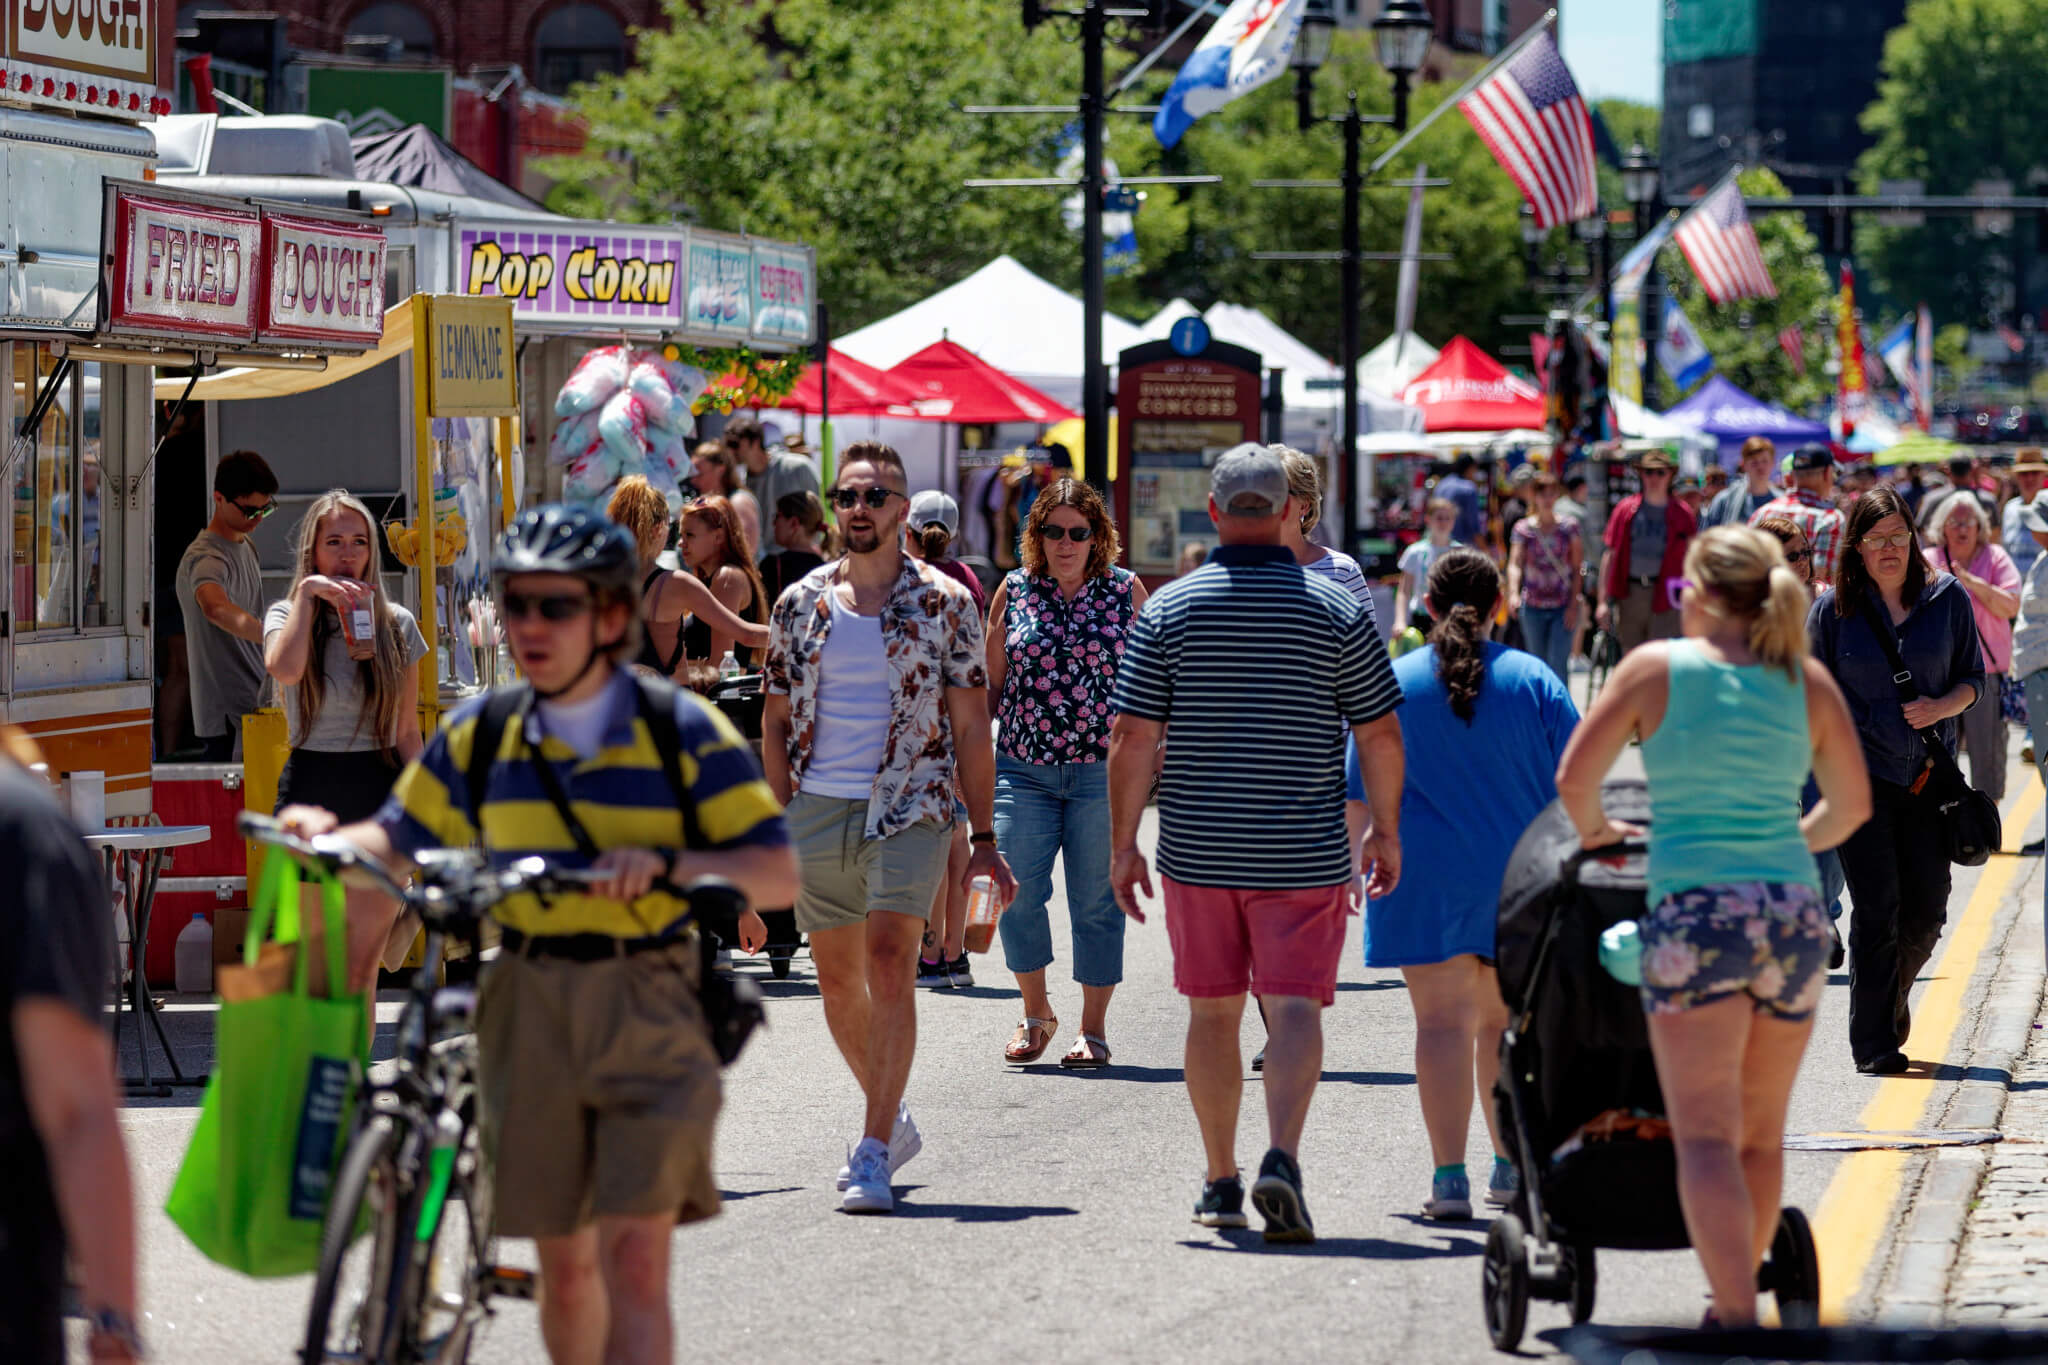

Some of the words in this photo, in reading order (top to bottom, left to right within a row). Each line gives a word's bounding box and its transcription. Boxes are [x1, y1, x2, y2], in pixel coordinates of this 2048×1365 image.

[145, 222, 241, 306] FRIED
[281, 240, 376, 317] DOUGH
[469, 241, 553, 298] POP
[564, 247, 675, 304] CORN
[440, 324, 504, 382] LEMONADE
[1137, 398, 1237, 415] CONCORD
